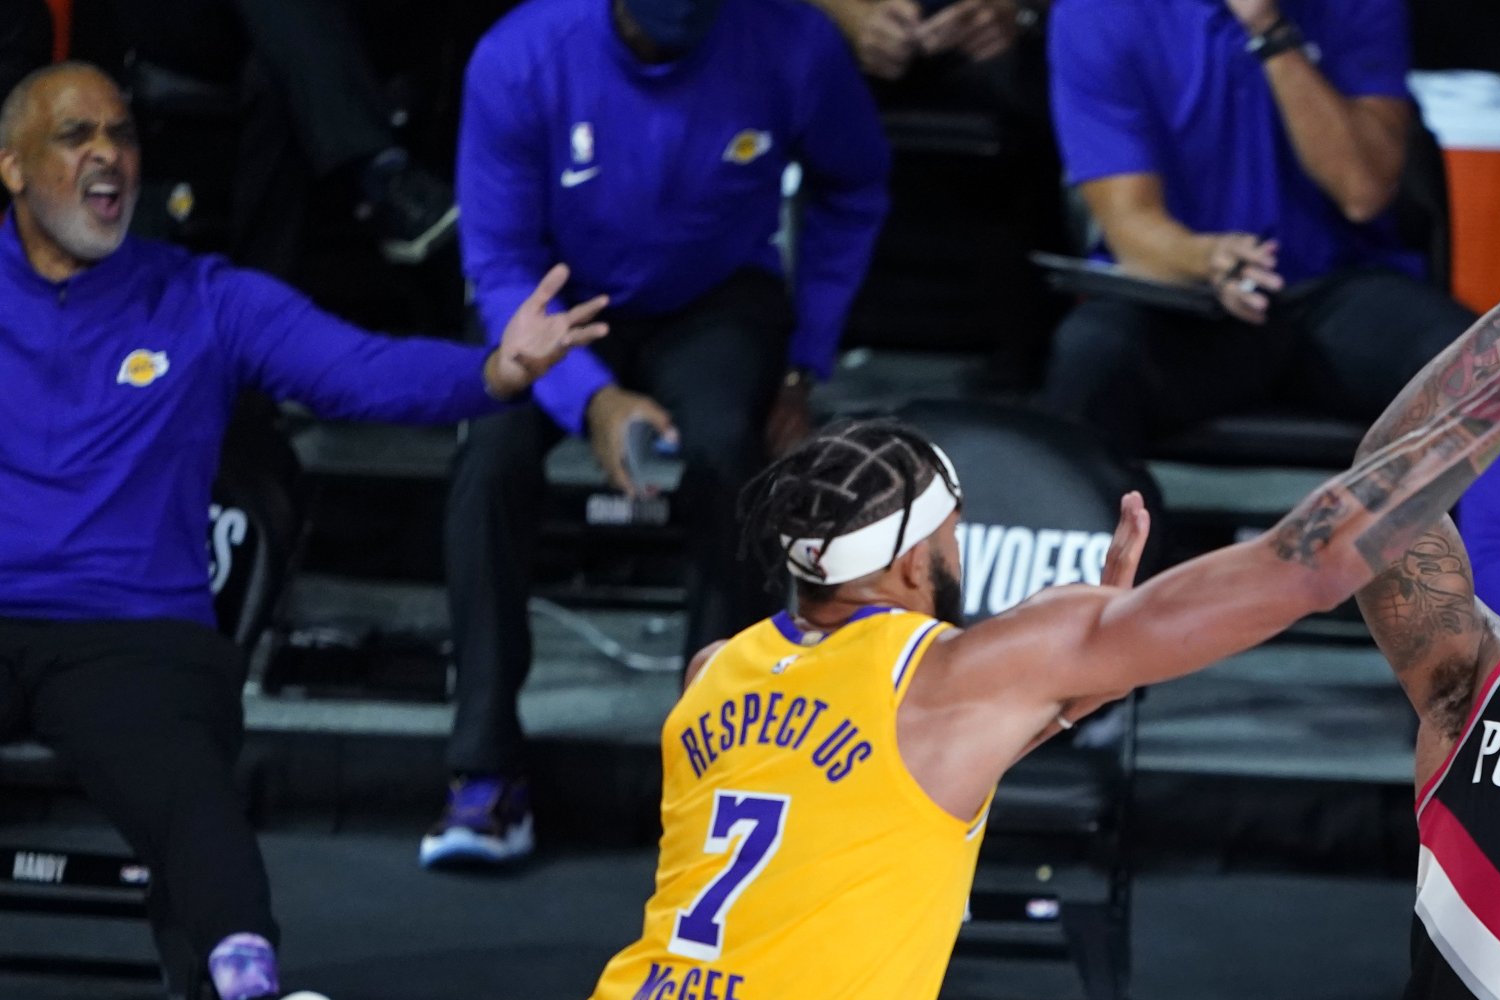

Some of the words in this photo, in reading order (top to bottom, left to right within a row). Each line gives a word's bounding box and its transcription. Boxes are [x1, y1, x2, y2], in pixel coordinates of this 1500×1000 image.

[955, 523, 1113, 615] YOFFS
[680, 692, 828, 780] RESPECT
[811, 718, 872, 782] US
[667, 789, 792, 961] 7
